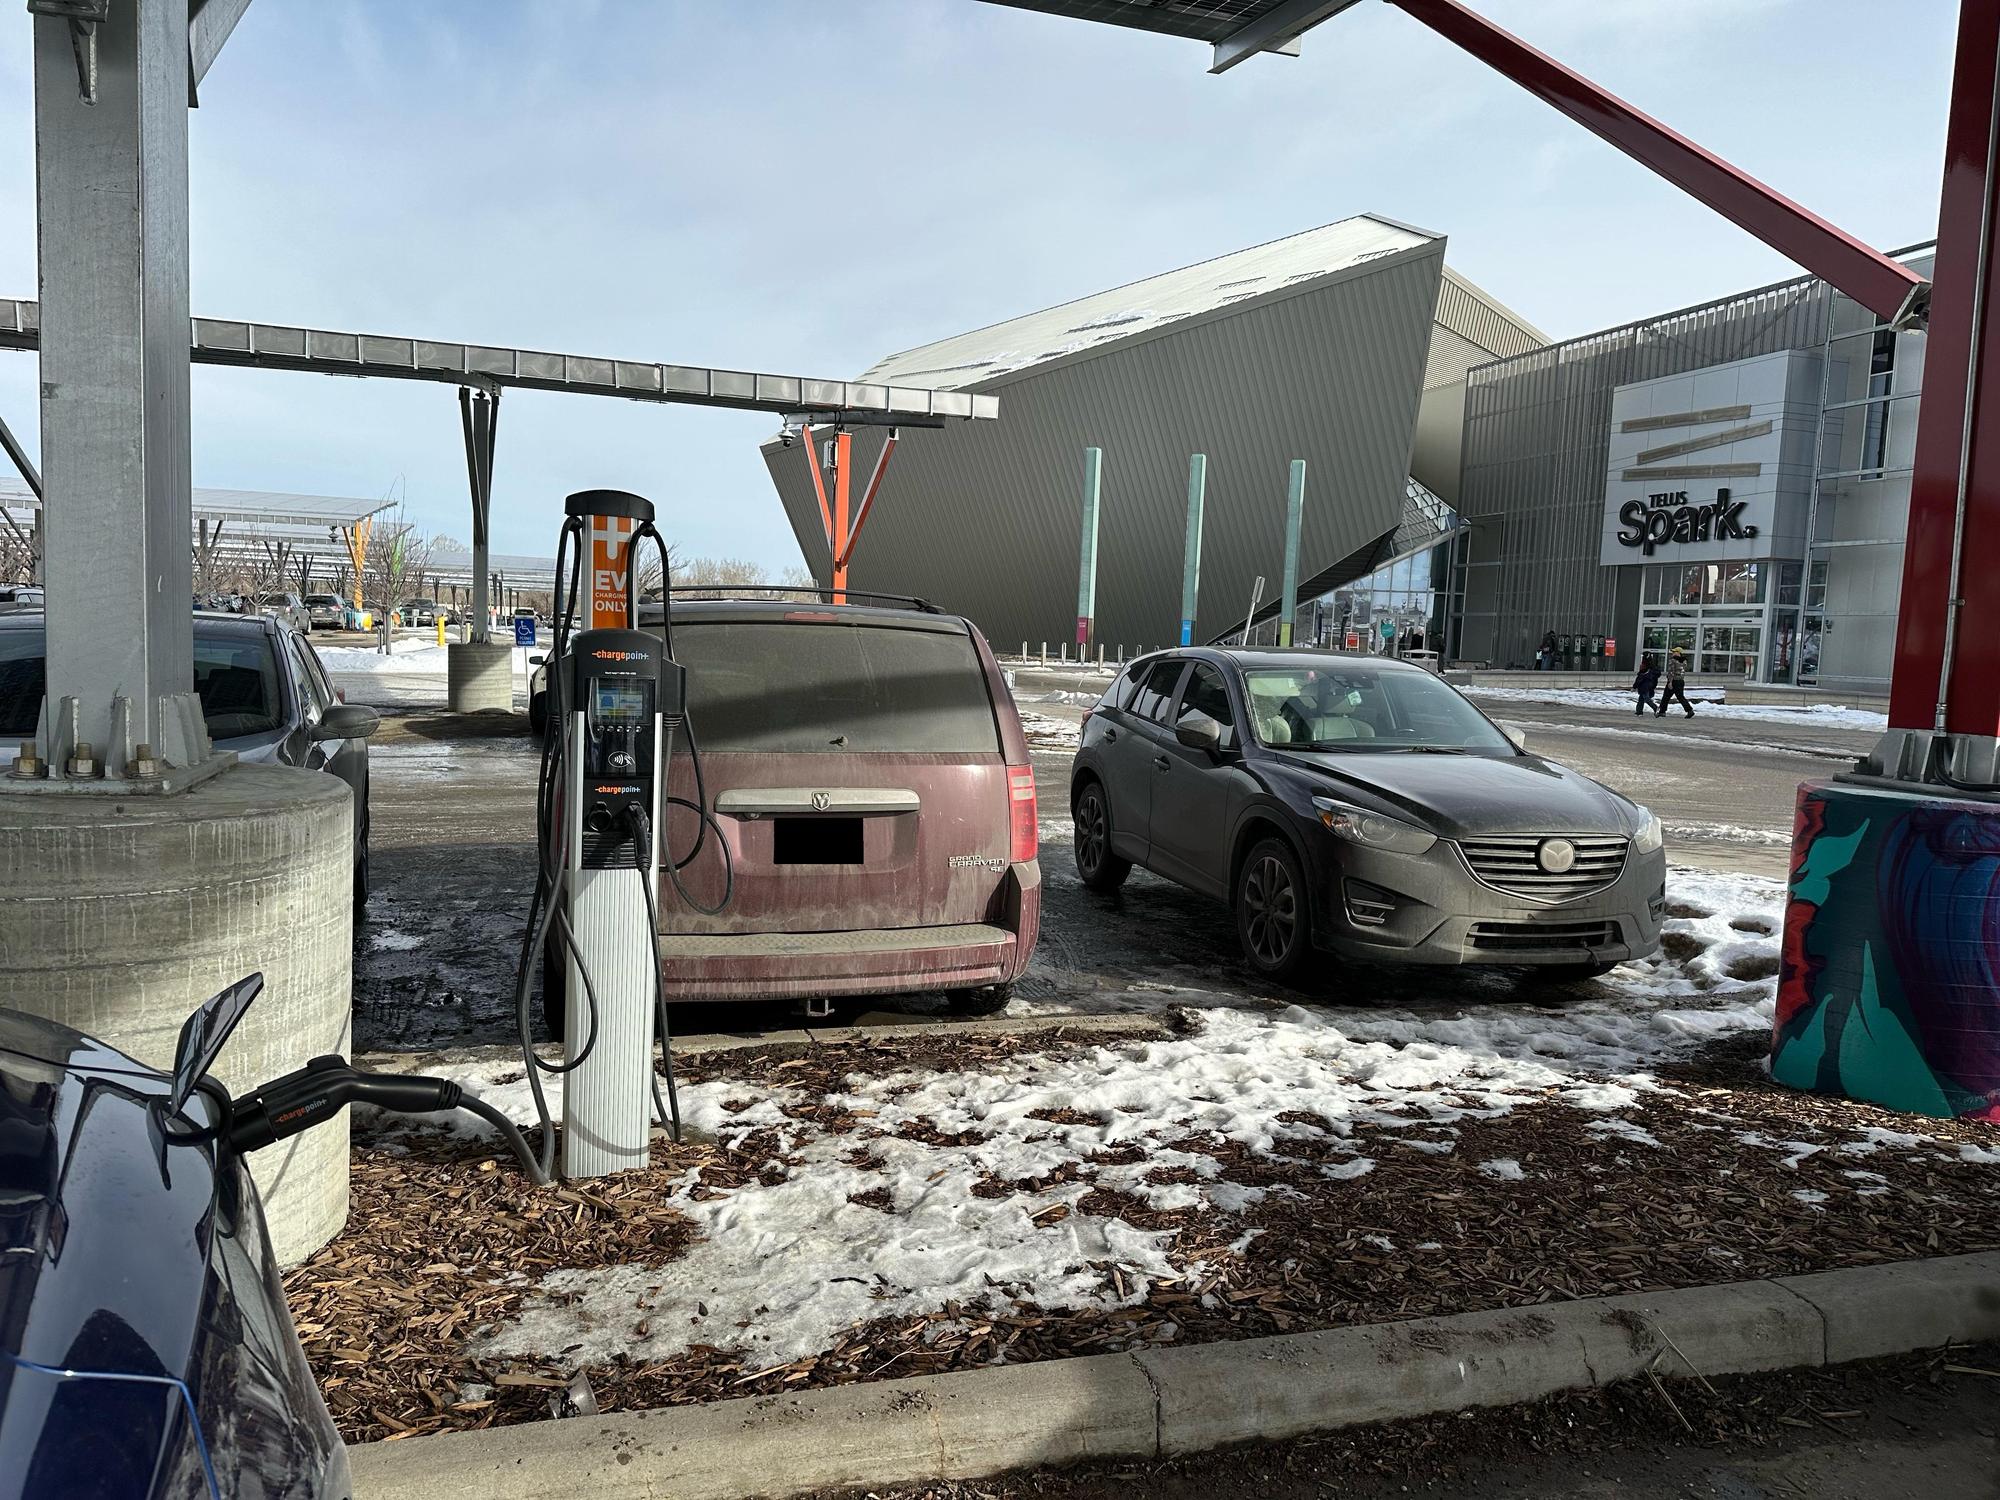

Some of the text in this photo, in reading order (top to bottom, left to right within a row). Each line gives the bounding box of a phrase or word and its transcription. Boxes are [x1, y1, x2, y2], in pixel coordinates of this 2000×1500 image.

[1649, 491, 1688, 508] TELUS
[595, 570, 627, 591] EV
[595, 601, 627, 612] ONLY
[948, 859, 1005, 868] CARAVAN
